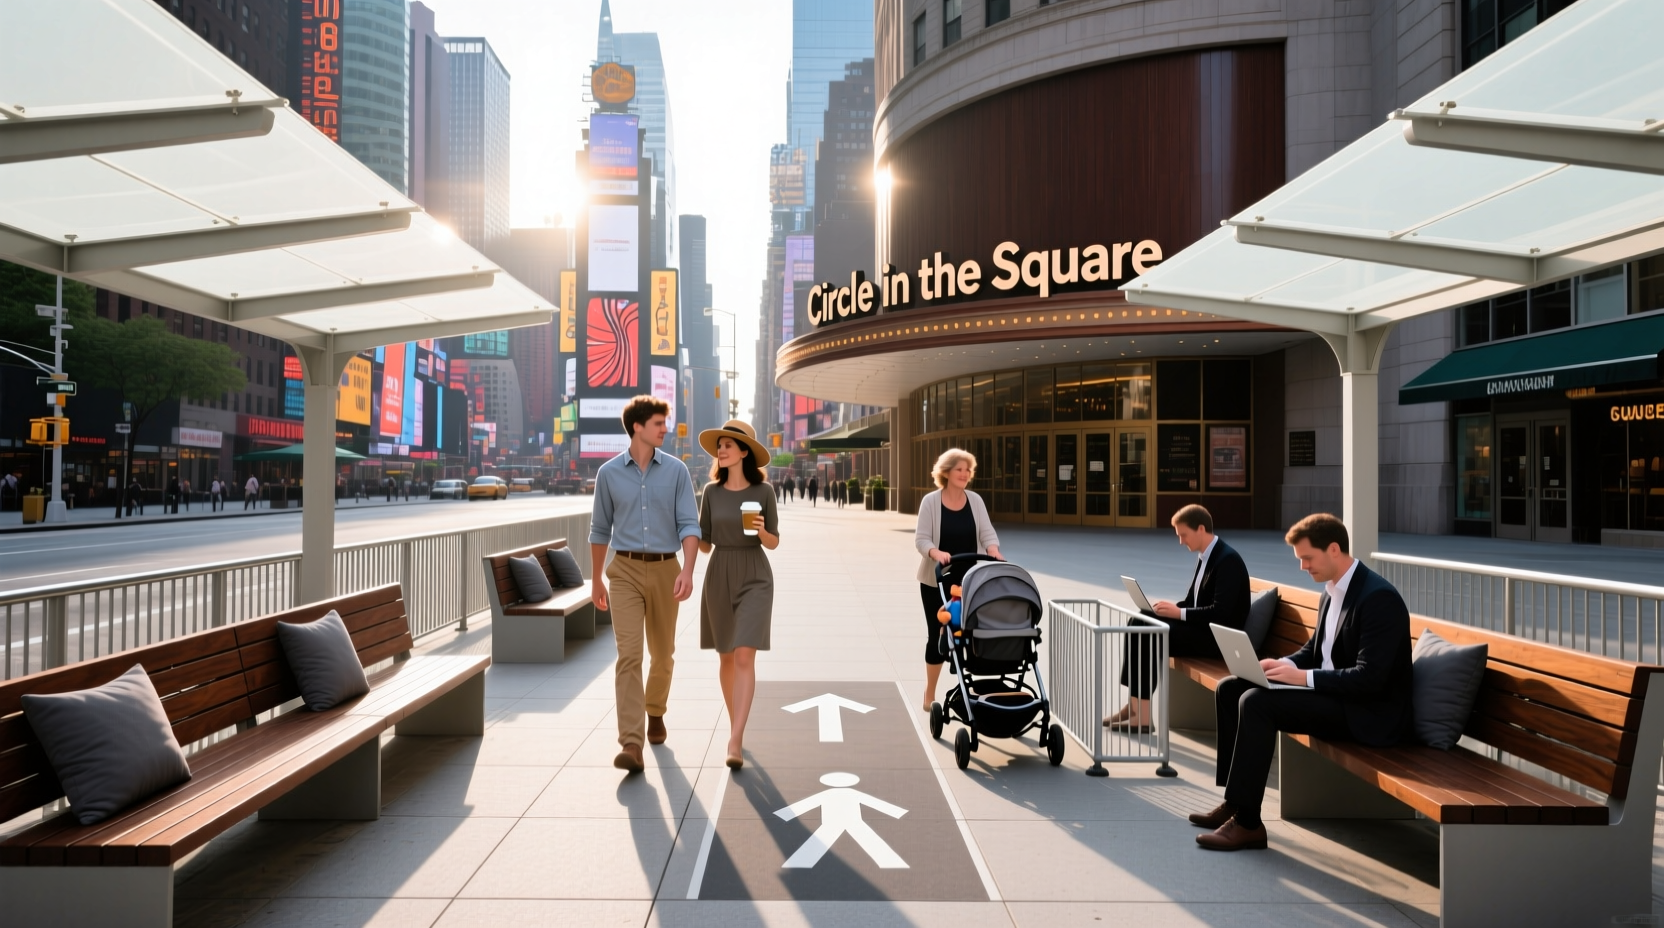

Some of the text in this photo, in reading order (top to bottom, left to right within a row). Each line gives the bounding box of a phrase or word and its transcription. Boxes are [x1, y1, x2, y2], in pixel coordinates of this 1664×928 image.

[807, 239, 1163, 327] Circle in the Square
